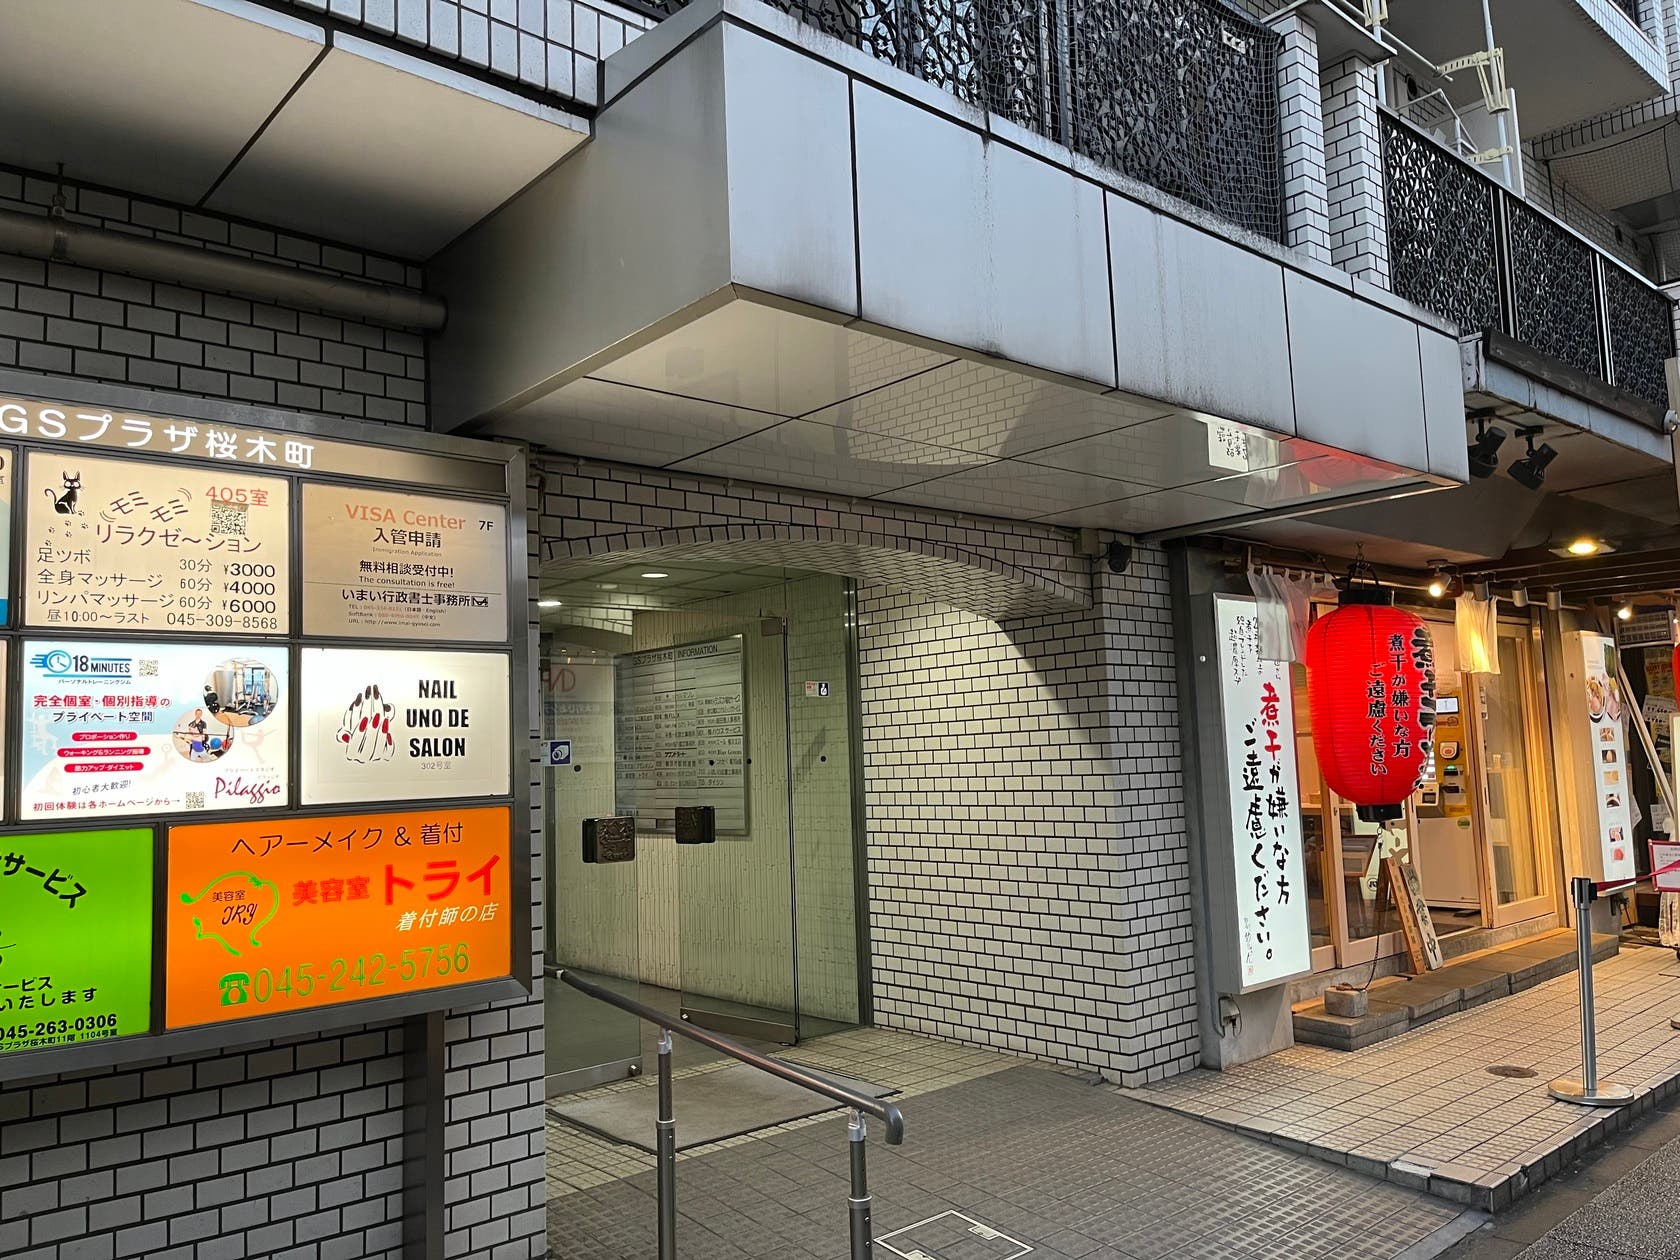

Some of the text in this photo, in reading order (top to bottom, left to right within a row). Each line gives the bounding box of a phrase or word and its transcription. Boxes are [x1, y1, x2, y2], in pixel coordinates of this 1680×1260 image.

[0, 404, 313, 469] GSプラザ桜木町
[205, 486, 269, 507] 405室
[345, 503, 466, 530] VISA Center
[478, 520, 494, 531] 7F
[373, 527, 441, 548] 入管申請
[37, 546, 91, 564] 足ツボ
[179, 559, 276, 577] 30分 ¥3000
[37, 568, 163, 588] 全身マッサージ
[180, 578, 276, 595] 60分 ¥4000
[359, 576, 374, 584] The
[376, 577, 426, 587] consultation
[437, 580, 455, 589] free!
[37, 590, 276, 613] リンパマッサージ 60分 ¥6000
[341, 589, 471, 607] いまい行政書士事務所
[167, 612, 278, 630] 045-309-8568
[677, 645, 719, 659] INFORMATION
[73, 655, 130, 674] 18 MINUTES
[418, 680, 457, 699] NAIL
[1387, 633, 1411, 759] 煮干が嫌いな方
[53, 711, 153, 722] プライベート空間
[406, 709, 469, 728] UNO DE
[1366, 663, 1388, 776] ご遠慮ください
[409, 738, 466, 757] SALON
[215, 776, 280, 804] Pilaggio
[1260, 682, 1290, 905] 煮干が嫌いな方
[231, 822, 463, 857] ヘアーメイク & 着付
[0, 852, 87, 909] サービス
[292, 855, 500, 906] 美容室 トライ
[212, 889, 246, 902] 美容室
[395, 902, 499, 932] 着付師の店
[254, 943, 470, 1003] 045-242-5756
[0, 976, 53, 991] ービス
